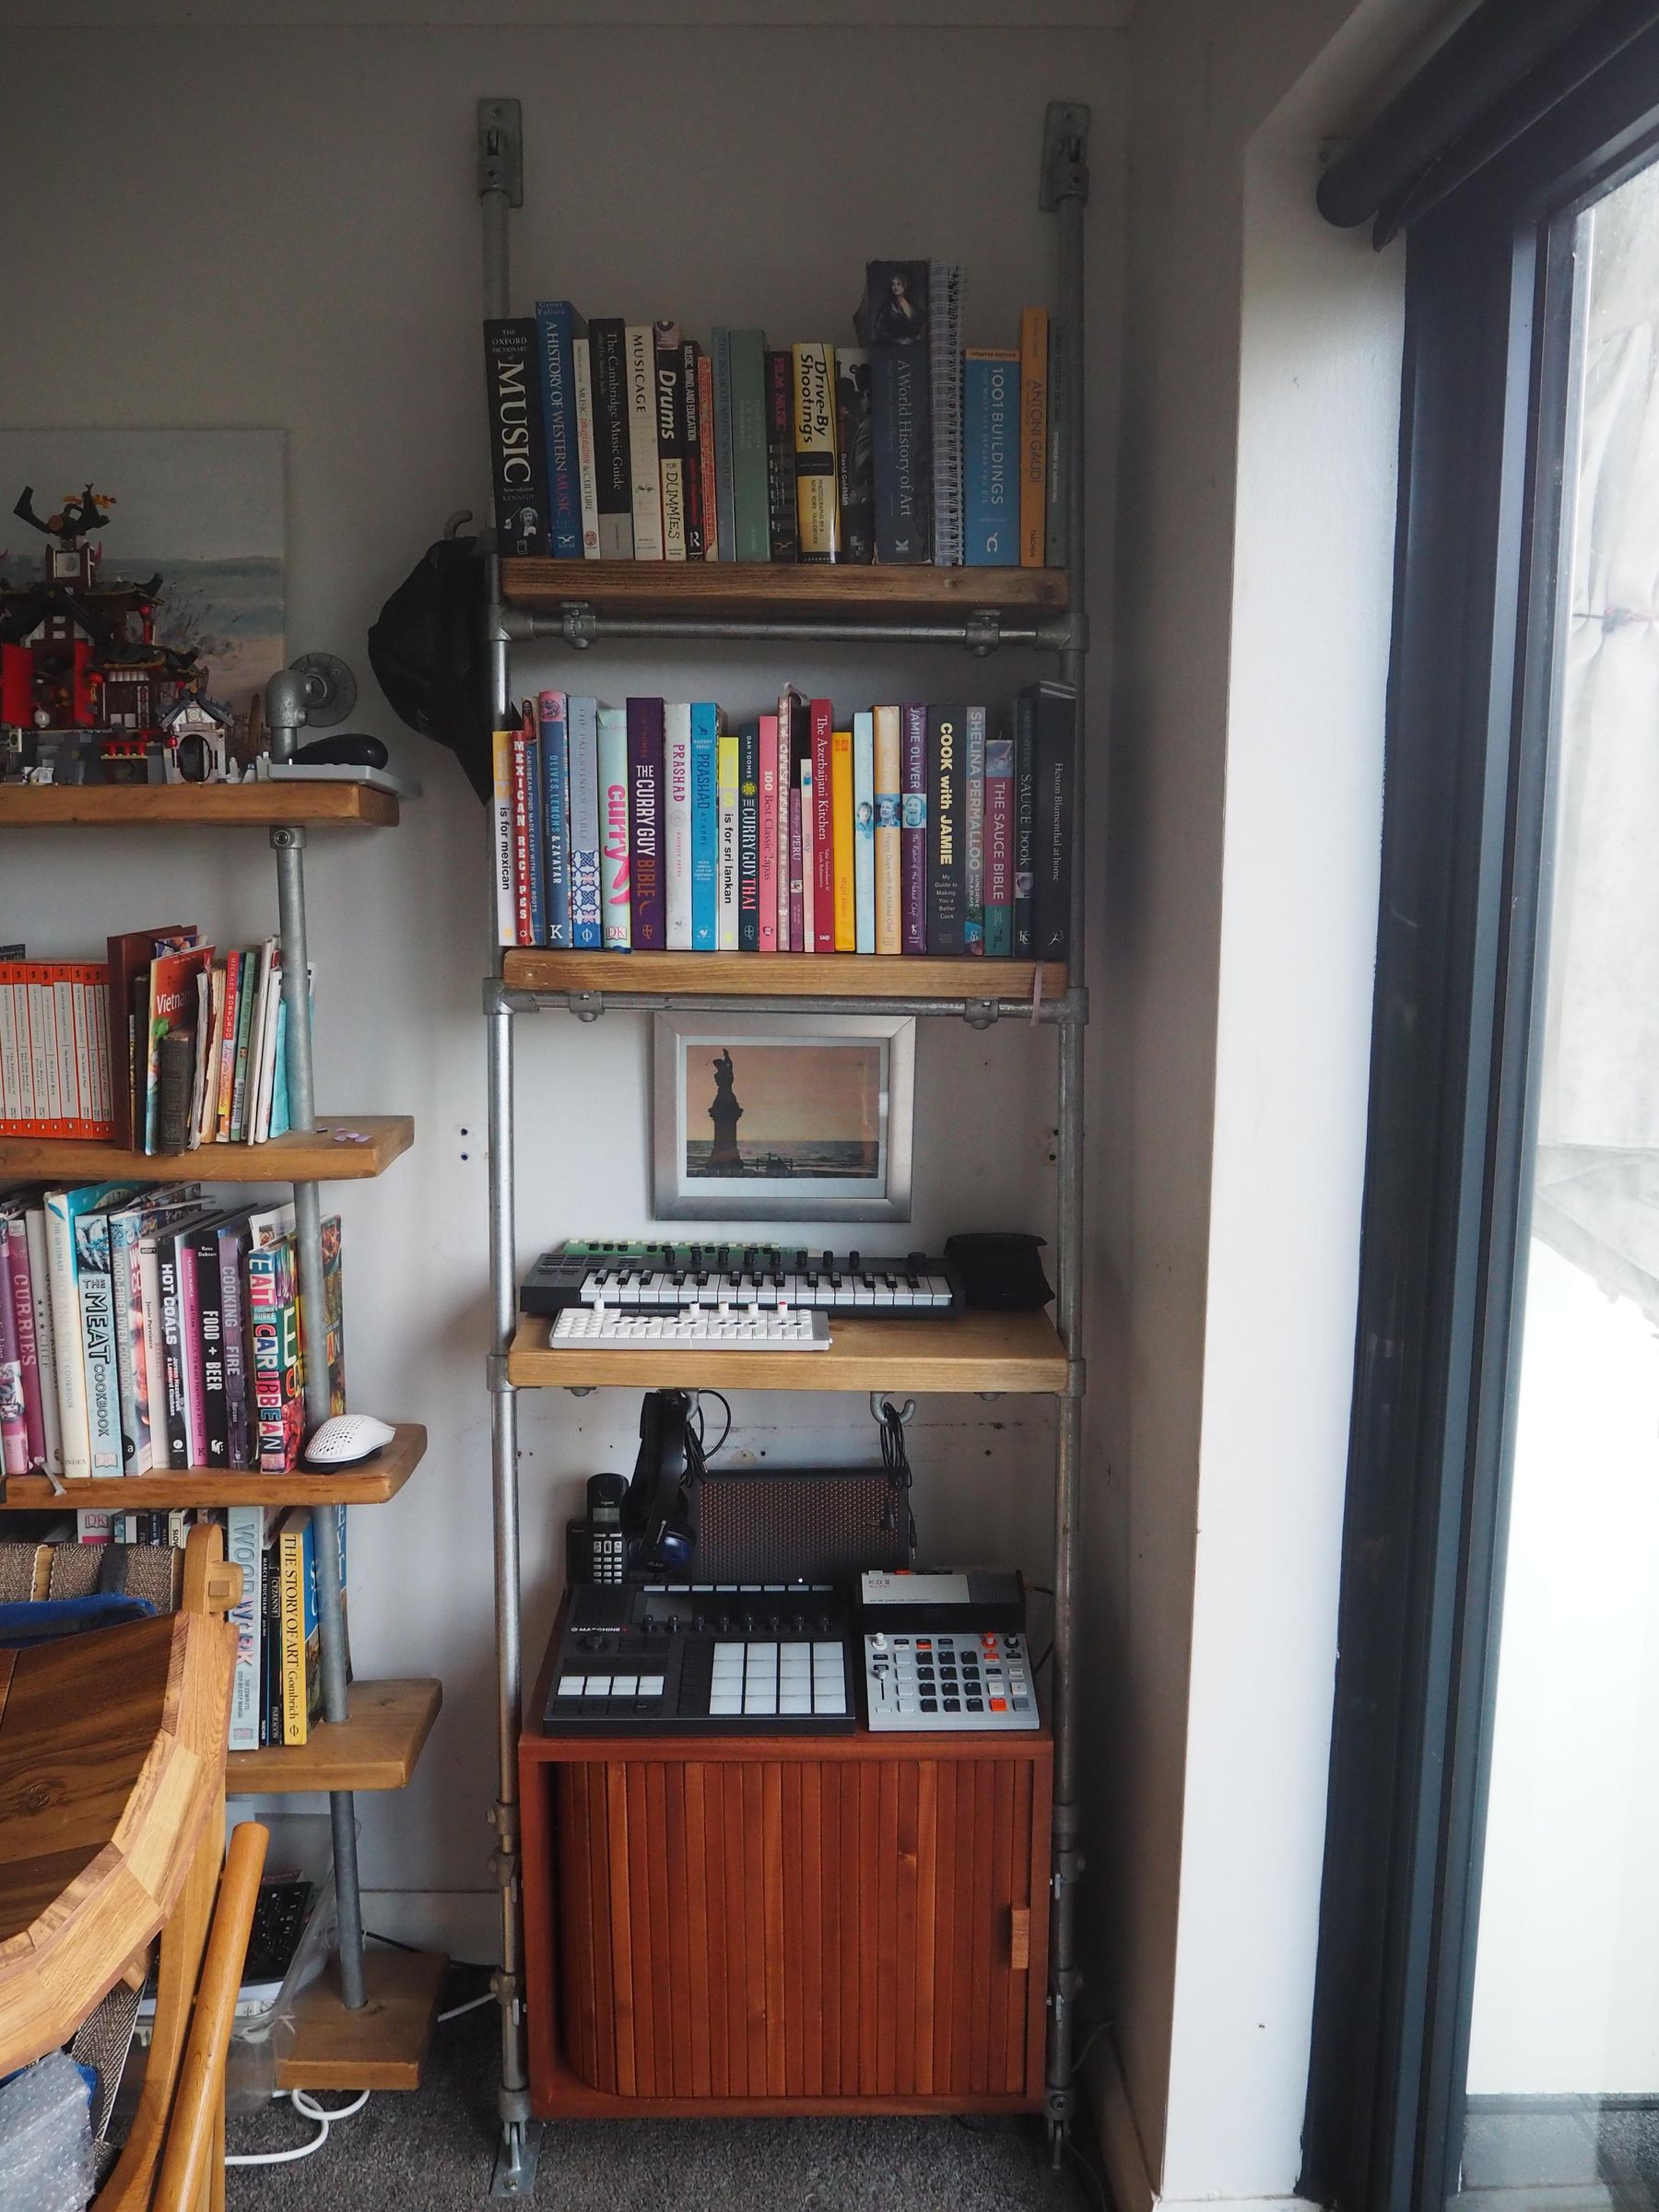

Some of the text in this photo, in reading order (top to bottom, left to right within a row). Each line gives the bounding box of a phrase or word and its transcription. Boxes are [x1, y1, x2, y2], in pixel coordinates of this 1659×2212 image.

[606, 331, 624, 490] The Cambridge Music Guide
[633, 335, 646, 413] MUSICAGE
[659, 369, 677, 441] Drums
[773, 358, 785, 388] FILM
[799, 354, 815, 443] Shootings
[813, 360, 830, 436] Drive-By
[1031, 380, 1042, 436] ANTONI
[498, 359, 532, 483] MUSIC
[546, 321, 571, 516] A HISTORY OF WESTERN MUSIC
[578, 417, 591, 464] imagination
[686, 390, 697, 441] AND EDUCATION
[895, 359, 914, 517] A World History of Art
[991, 367, 1005, 504] 1001 BUILDINGS
[502, 493, 535, 501] KENNEDY
[583, 473, 593, 512] CULTURE
[841, 453, 849, 473] David
[665, 472, 681, 539] DUMMIES
[578, 708, 588, 841] THE PALESTINIAN TABLE
[673, 744, 685, 802] PRASHAD
[697, 753, 710, 809] PRASHAD
[779, 744, 789, 783] CHINESE
[814, 714, 831, 841] The Azerbaijani Kitchen
[910, 707, 921, 789] JAMIE OLIVER
[513, 740, 527, 919] MEXICAN RECIPES
[604, 784, 629, 863] curry
[761, 771, 774, 881] 100 Best Classic Tapas
[779, 785, 789, 823] CUISINE
[940, 722, 954, 865] COOK with JAMIE
[969, 712, 982, 870] SHELINA PERMALLOO
[994, 782, 1006, 809] THE
[1019, 774, 1032, 865] SAUCE book
[1053, 762, 1063, 883] Heston Blumenthal home
[500, 807, 512, 890] is for mexican
[550, 794, 562, 884] LEMONS & ZA'ATAR
[636, 765, 656, 898] THE CURRY GUY BIBLE
[724, 813, 734, 904] is for sri lankan
[743, 799, 757, 910] THE CURRY GUY THAI
[792, 834, 801, 861] PERU
[884, 832, 892, 853] Happy
[885, 854, 893, 870] Days
[994, 813, 1005, 858] SAUCE
[886, 896, 894, 917] Naked
[993, 864, 1005, 900] BIBLE
[549, 924, 563, 939] K
[886, 918, 894, 933] Chef
[225, 957, 237, 1039] MICHAEL MORPURGO
[161, 1264, 178, 1346] HOT COALS
[222, 1265, 239, 1327] COOKING
[249, 1257, 275, 1305] EAT
[14, 1274, 37, 1366] CURRIES
[40, 1335, 50, 1369] CHEF
[54, 1238, 74, 1409] ULTIMATE COOKBOOK
[83, 1279, 112, 1438] THE MEAT COOKBOOK
[112, 1253, 132, 1397] WOOD-FIRED OVEN COOKBOOK
[202, 1310, 220, 1341] FOOD
[206, 1361, 223, 1391] BEER
[226, 1346, 240, 1376] FIRE
[254, 1324, 284, 1451] CARIBBEAN
[86, 1514, 107, 1527] DK
[284, 1535, 300, 1720] THE STORY OF ART Gombrich
